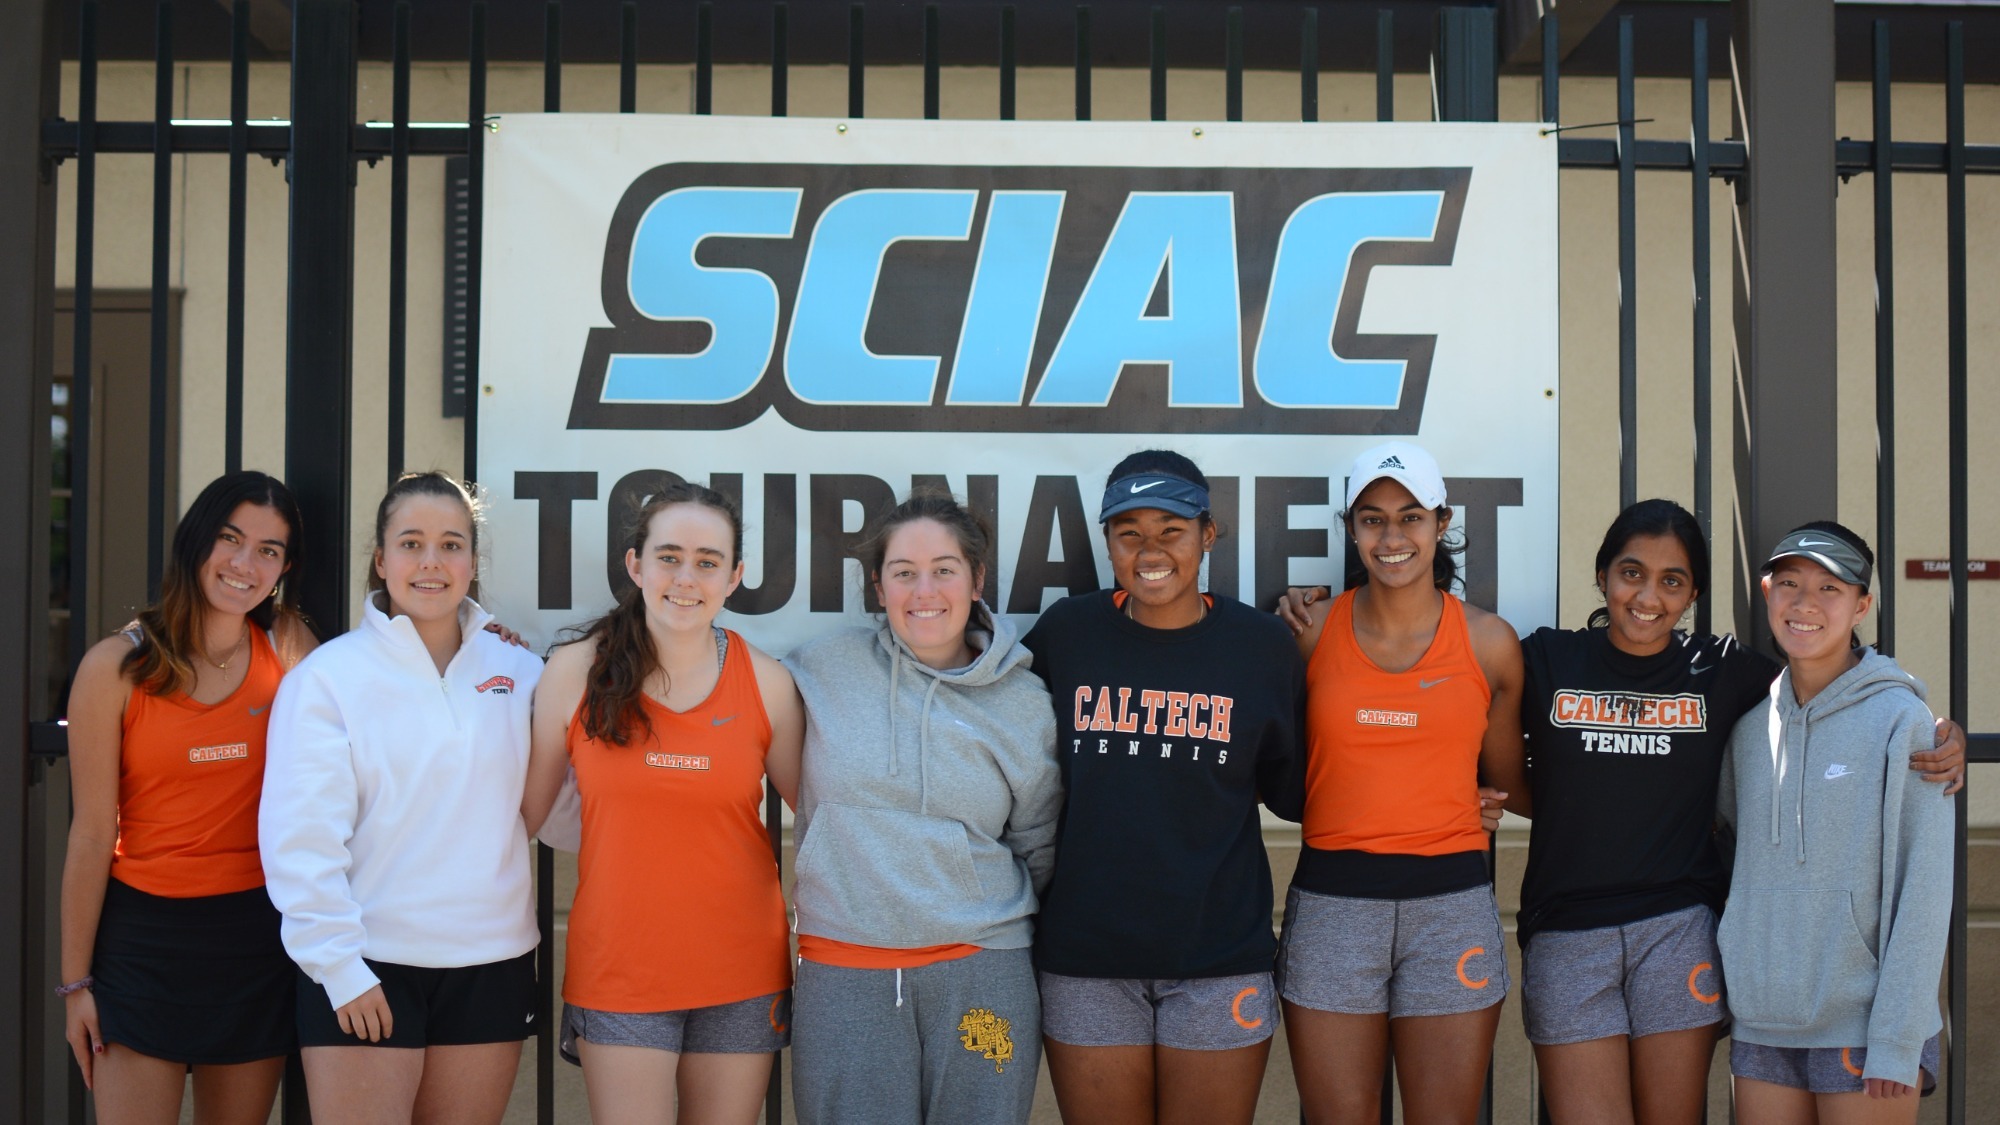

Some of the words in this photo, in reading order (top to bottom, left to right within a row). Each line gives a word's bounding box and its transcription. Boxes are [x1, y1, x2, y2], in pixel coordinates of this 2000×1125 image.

[599, 186, 1446, 411] SCIAC
[1073, 685, 1234, 743] CALTECH
[1357, 709, 1417, 727] CALTECH
[1552, 690, 1705, 731] CALTECH
[189, 743, 247, 763] CALTECH
[645, 752, 709, 770] CALTECH
[1073, 739, 1228, 765] TENNIS
[1581, 731, 1672, 755] TENNIS
[1456, 946, 1489, 990] C
[1687, 962, 1720, 1004] C
[1232, 987, 1262, 1029] C
